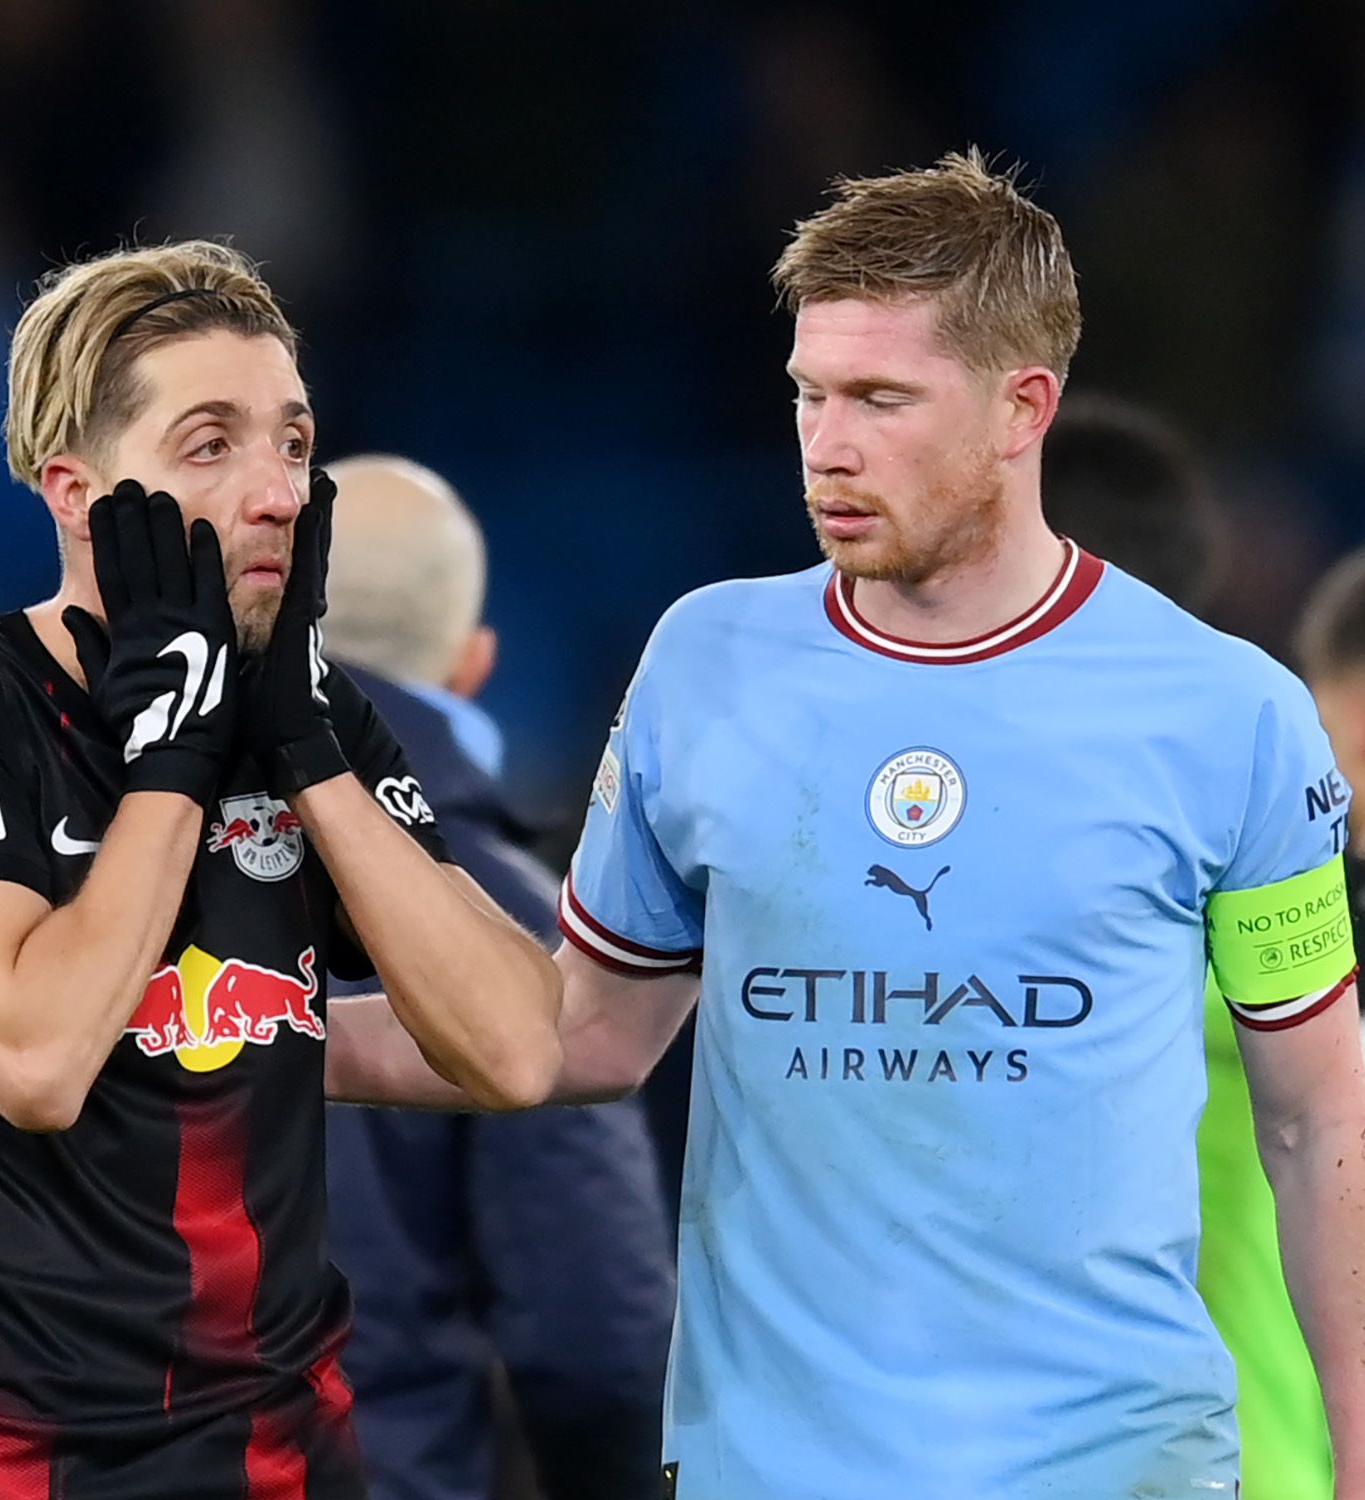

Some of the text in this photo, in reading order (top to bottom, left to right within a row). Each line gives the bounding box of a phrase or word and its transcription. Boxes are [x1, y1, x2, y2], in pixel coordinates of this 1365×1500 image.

[880, 754, 957, 786] MANCHESTER
[898, 831, 926, 841] CITY
[1237, 882, 1344, 934] NO TO RACIS
[741, 967, 1093, 1027] ETIHAD
[785, 1046, 1029, 1083] AIRWAYS
